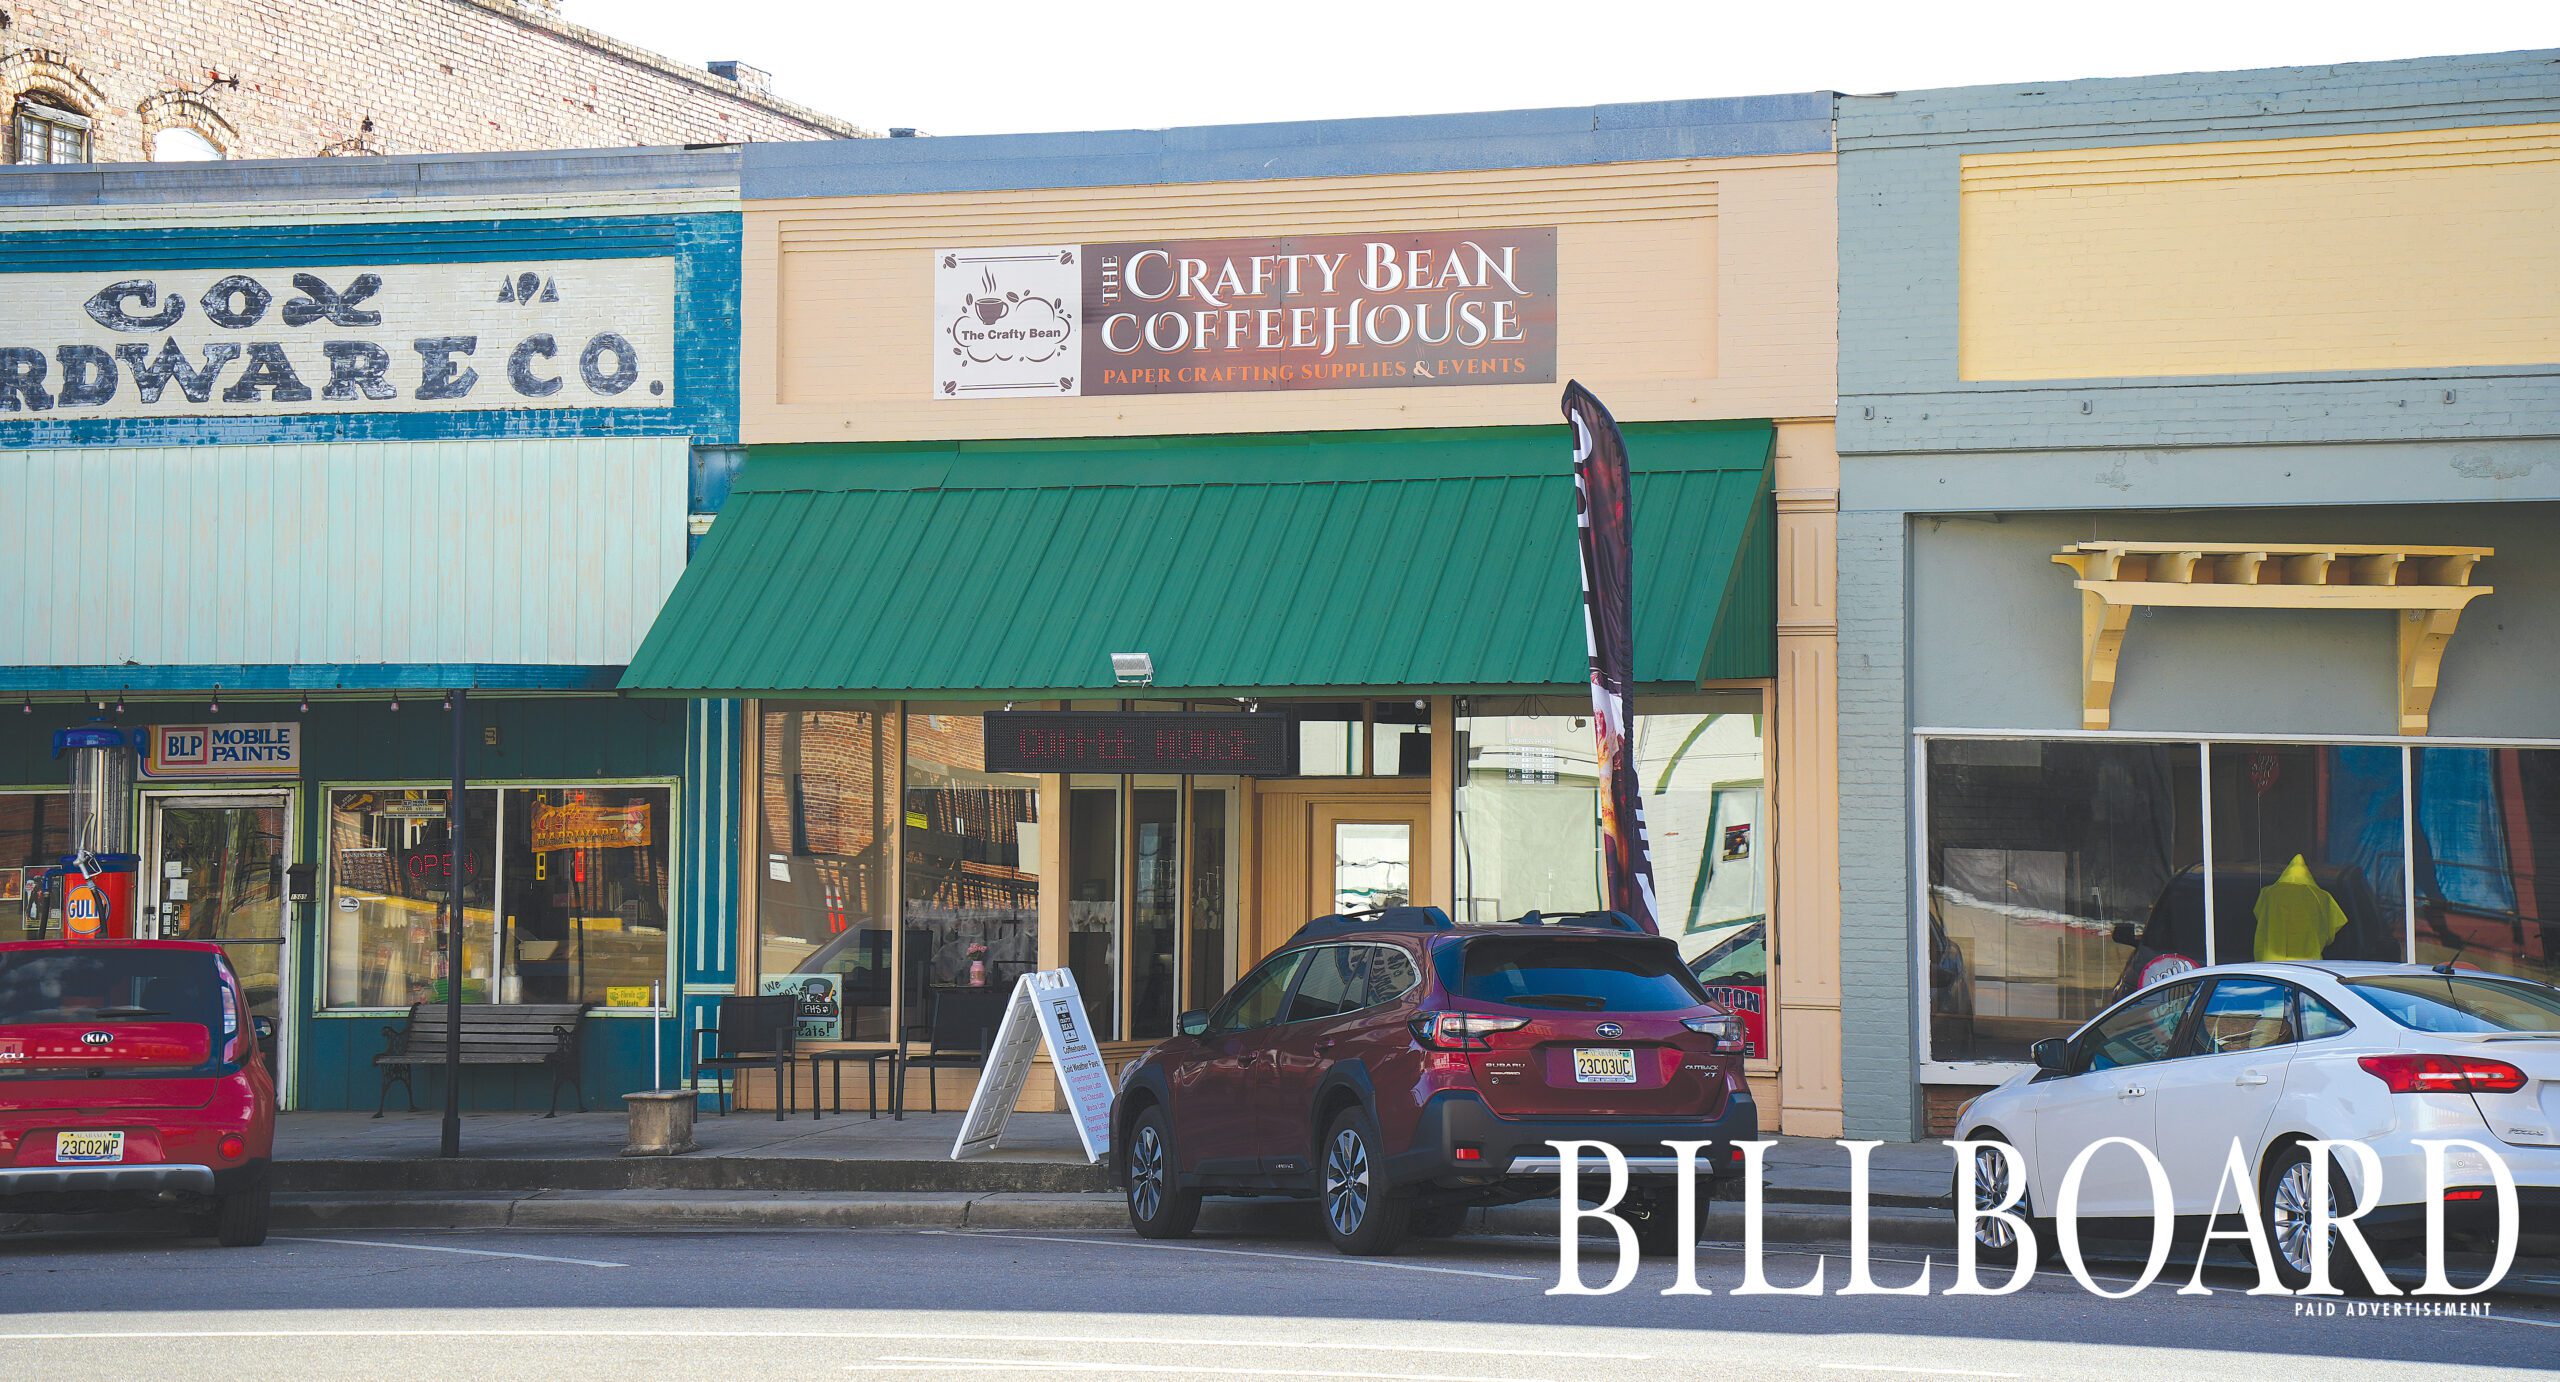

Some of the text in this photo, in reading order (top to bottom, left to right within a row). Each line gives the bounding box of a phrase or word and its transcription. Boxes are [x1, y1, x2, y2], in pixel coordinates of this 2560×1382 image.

[1102, 255, 1121, 305] THE
[1124, 240, 1532, 307] CRAFTY BEAN
[84, 272, 383, 333] COX
[1102, 291, 1526, 356] COFFEEHOUSE
[962, 327, 1061, 341] The Crafty Bean
[0, 331, 665, 411] RDWARE CO.
[1104, 357, 1526, 385] PAPER CRAFTING SUPPLIES & EVENTS
[167, 728, 291, 757] BLP MOBILE
[211, 745, 291, 762] PAINTS
[408, 849, 474, 879] OPEN
[764, 980, 781, 993] We
[804, 1004, 822, 1014] FHS
[86, 1034, 109, 1043] KIA
[1062, 1044, 1088, 1055] Coffeehouse
[1063, 1063, 1074, 1074] Cold
[1579, 1058, 1631, 1075] 23C03UC
[61, 1140, 119, 1155] 23C02WP
